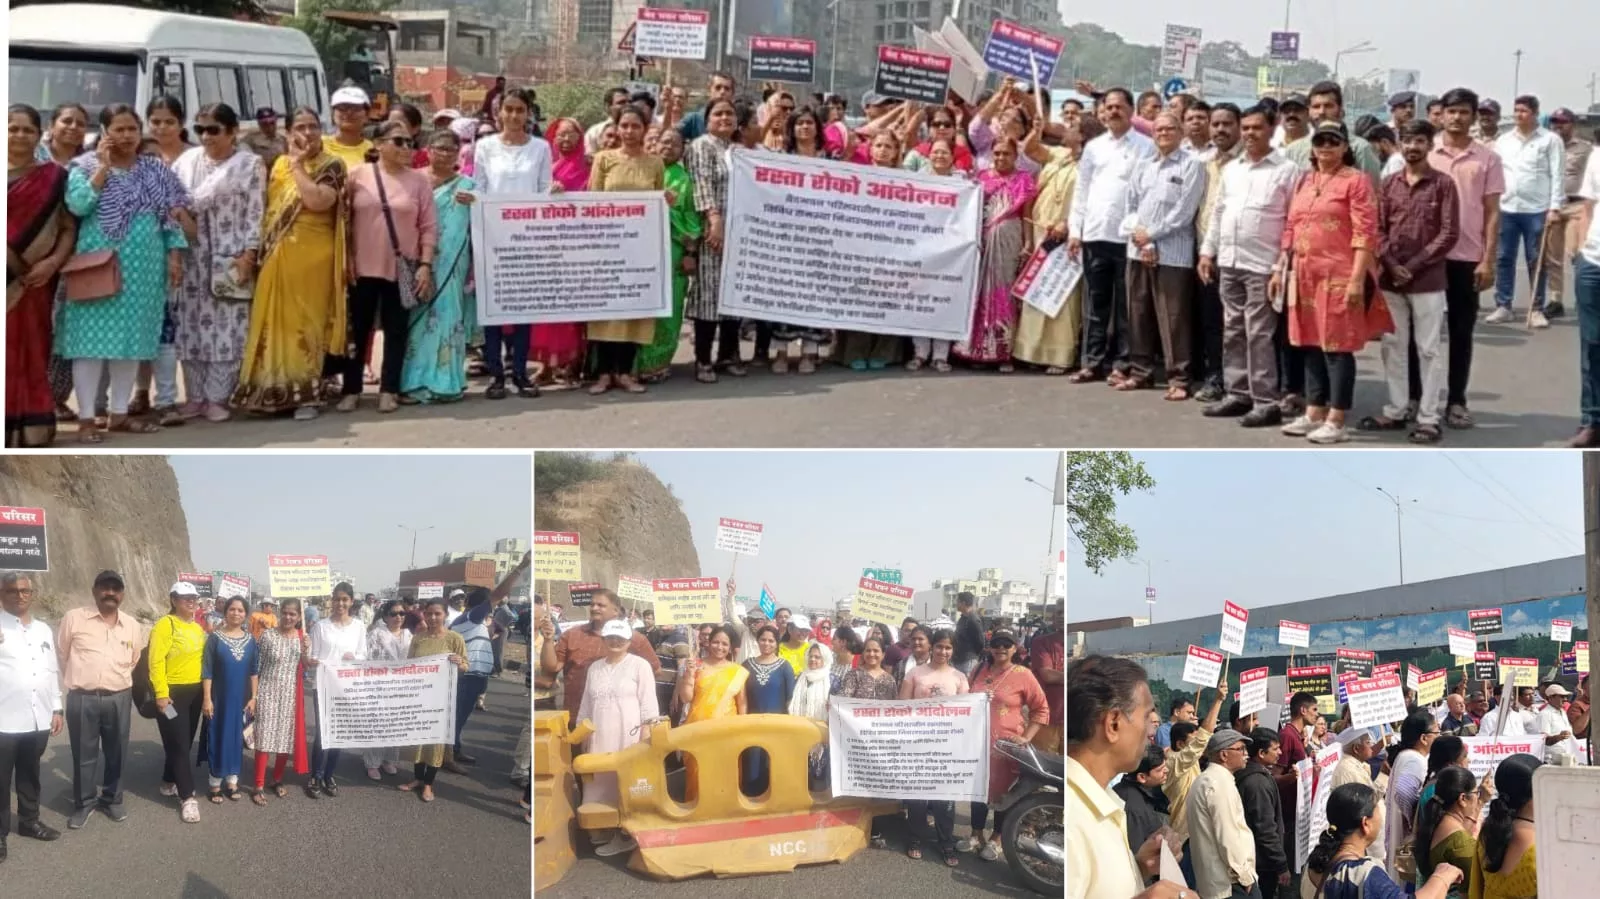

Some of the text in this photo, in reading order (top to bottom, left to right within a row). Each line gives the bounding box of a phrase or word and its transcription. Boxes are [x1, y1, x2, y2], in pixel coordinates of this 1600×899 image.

[755, 165, 958, 208] रस्ता रोको आंदोलन
[501, 203, 645, 220] रस्ता रोको आंदोलन
[1, 509, 37, 522] परिसर
[551, 533, 574, 543] परिसर
[657, 580, 669, 589] वेद
[691, 579, 713, 589] परिसर
[363, 667, 388, 677] रोको
[391, 663, 440, 675] आंदोलन
[852, 704, 972, 717] रस्ता रोको आंदोलन
[1473, 741, 1531, 755] आंदोलन
[770, 839, 806, 857] NCC
